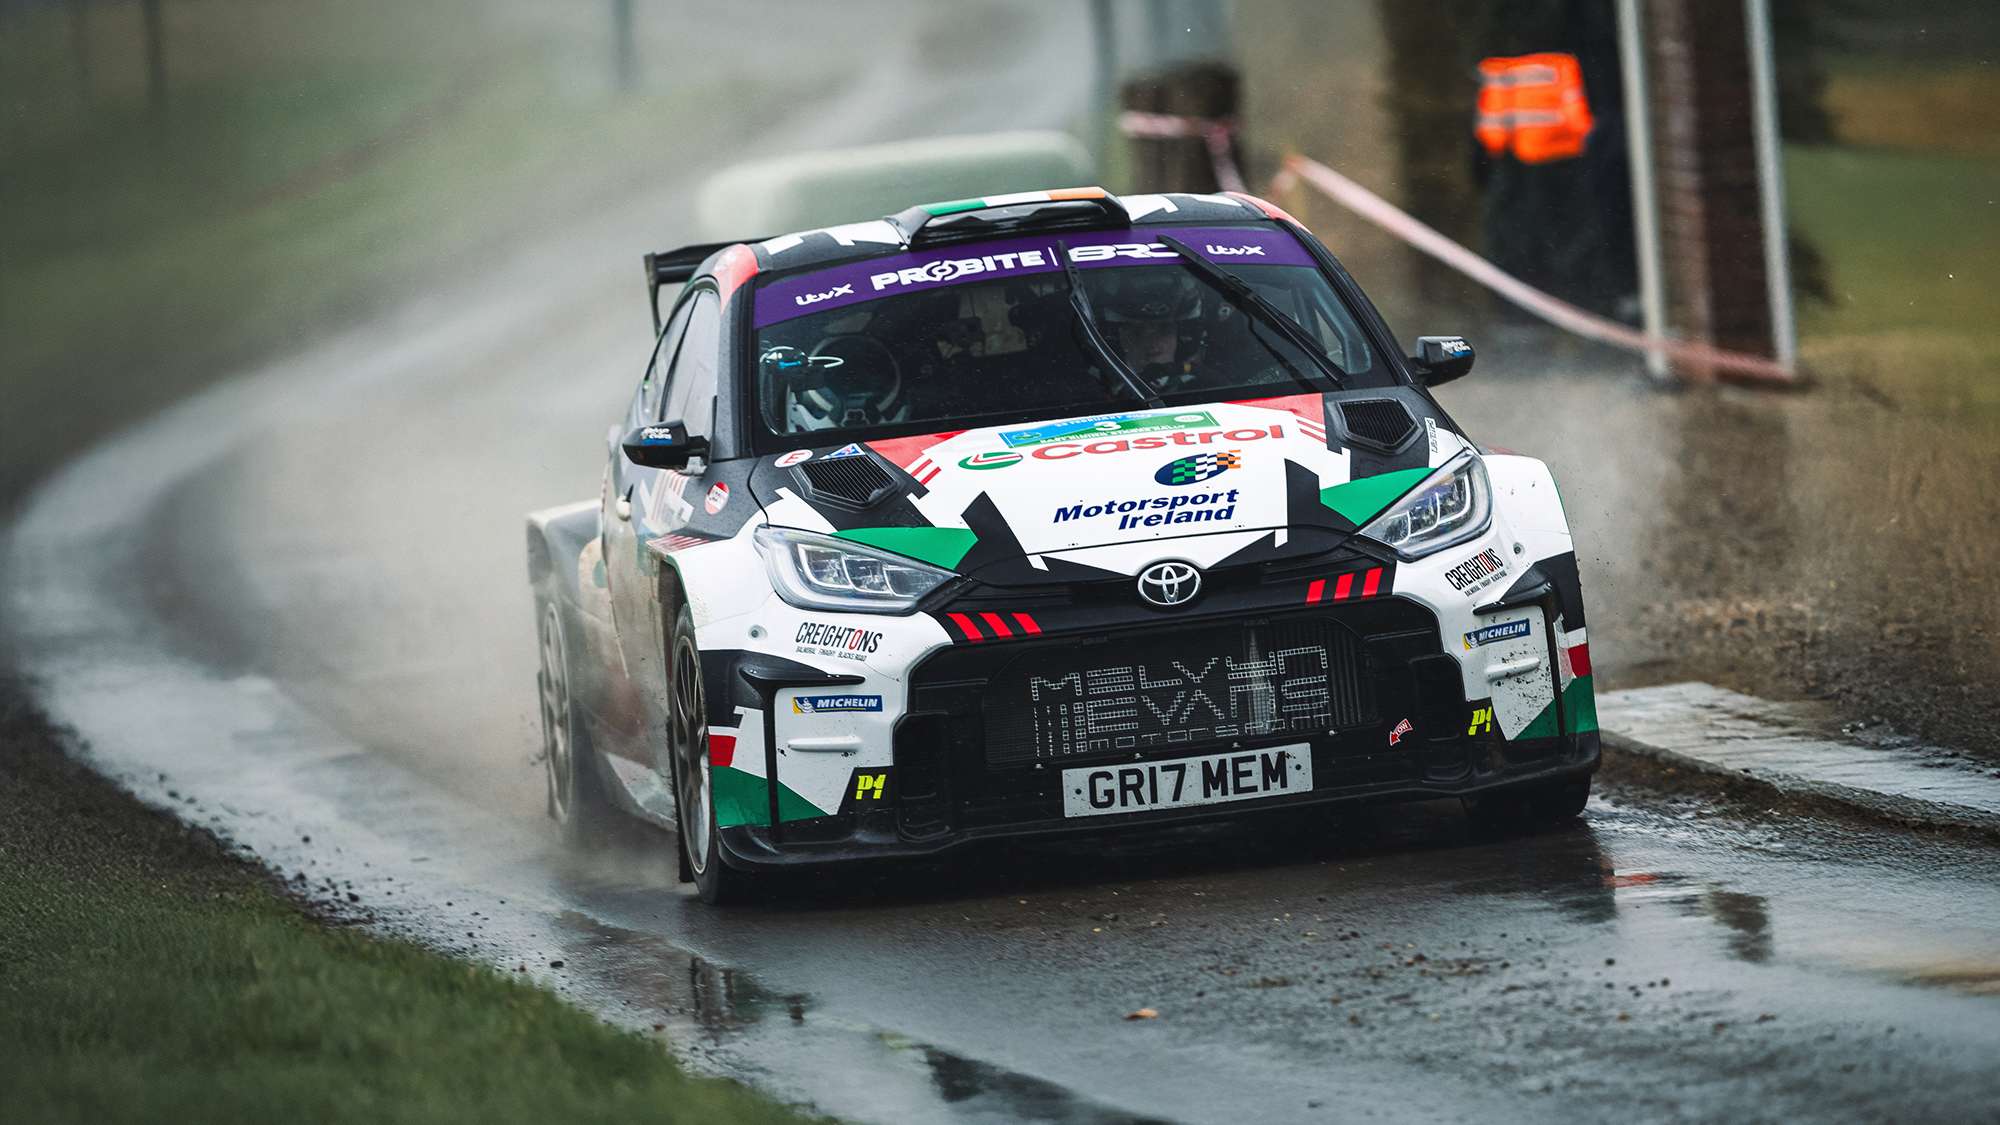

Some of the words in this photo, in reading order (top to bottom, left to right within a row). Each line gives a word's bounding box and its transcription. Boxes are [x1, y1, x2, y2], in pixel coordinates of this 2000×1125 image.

[870, 250, 1046, 291] PROBITE
[1067, 243, 1180, 263] BRC
[1031, 424, 1285, 460] Castrol
[1093, 421, 1122, 431] 3
[1053, 488, 1240, 523] Motorsport
[1118, 504, 1236, 530] Ireland
[1444, 547, 1504, 591] CREIGHTONS
[795, 622, 883, 653] CREIGHTONS
[1479, 622, 1527, 641] MICHELIN
[1031, 645, 1328, 701] MELVYN
[816, 698, 878, 708] MICHELIN
[1086, 674, 1330, 734] EVANS
[856, 774, 887, 800] P1
[1087, 763, 1187, 810] GR17
[1201, 750, 1288, 799] MEM
